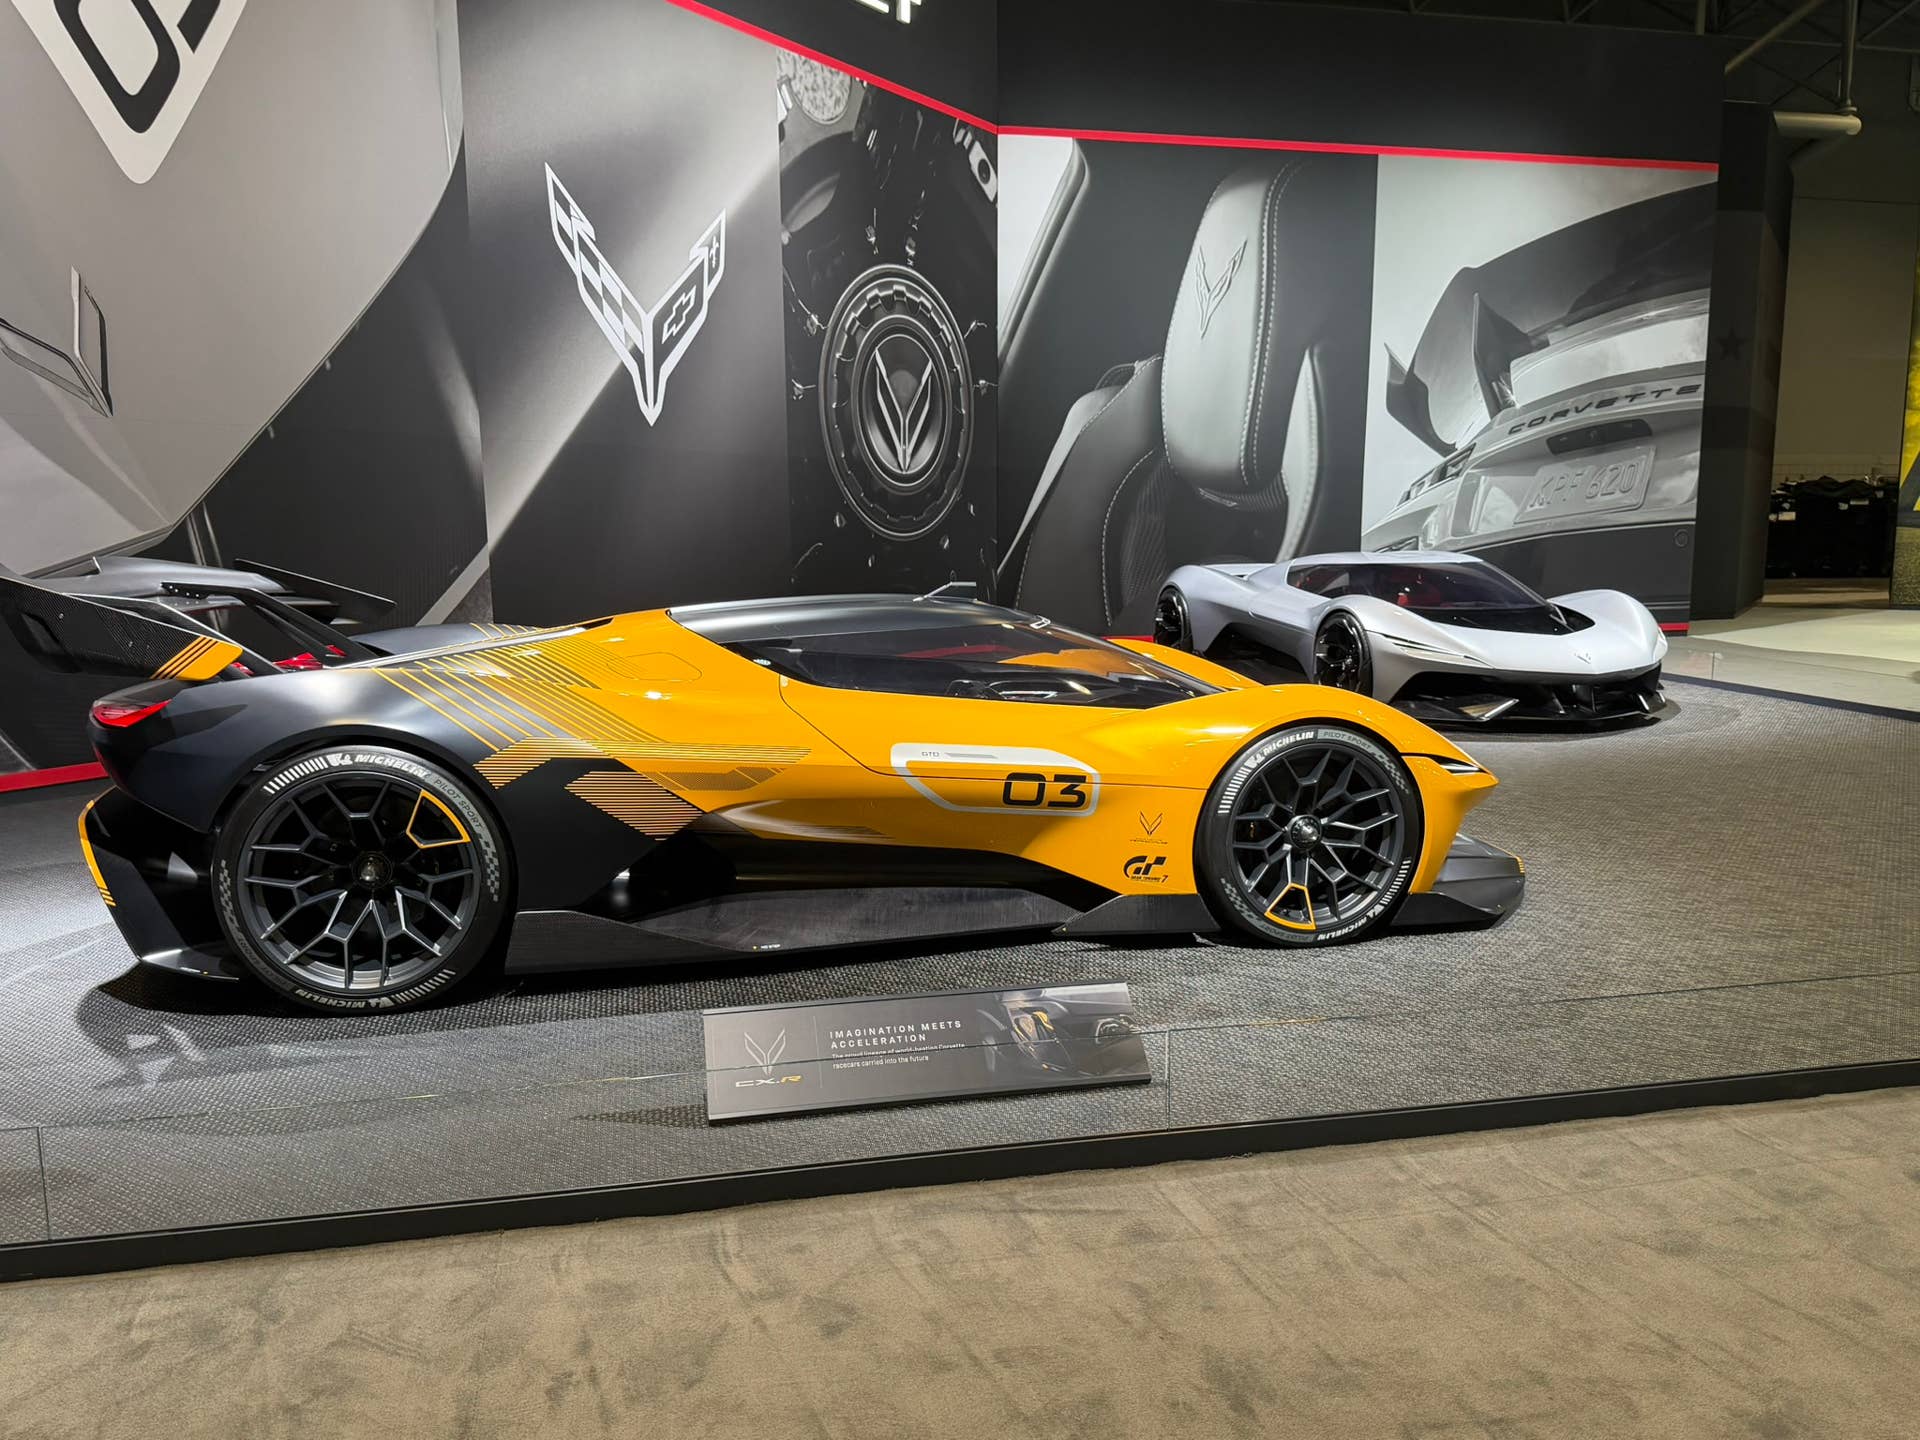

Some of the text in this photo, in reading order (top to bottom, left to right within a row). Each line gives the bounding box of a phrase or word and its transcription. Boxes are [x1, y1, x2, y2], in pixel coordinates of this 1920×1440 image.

[1509, 384, 1702, 435] CORVETTE
[1585, 462, 1641, 500] 620
[1262, 731, 1315, 755] MICHELIN
[1323, 731, 1372, 750] PILOT SPORT
[354, 754, 431, 781] MICHELIN
[1002, 772, 1087, 808] 03
[434, 779, 483, 828] PILOT SPORT
[1317, 916, 1368, 941] MICHELIN
[295, 989, 366, 1009] MICHELIN
[829, 1020, 961, 1039] IMAGINATION MEETS
[831, 1034, 926, 1049] ACCELERATION
